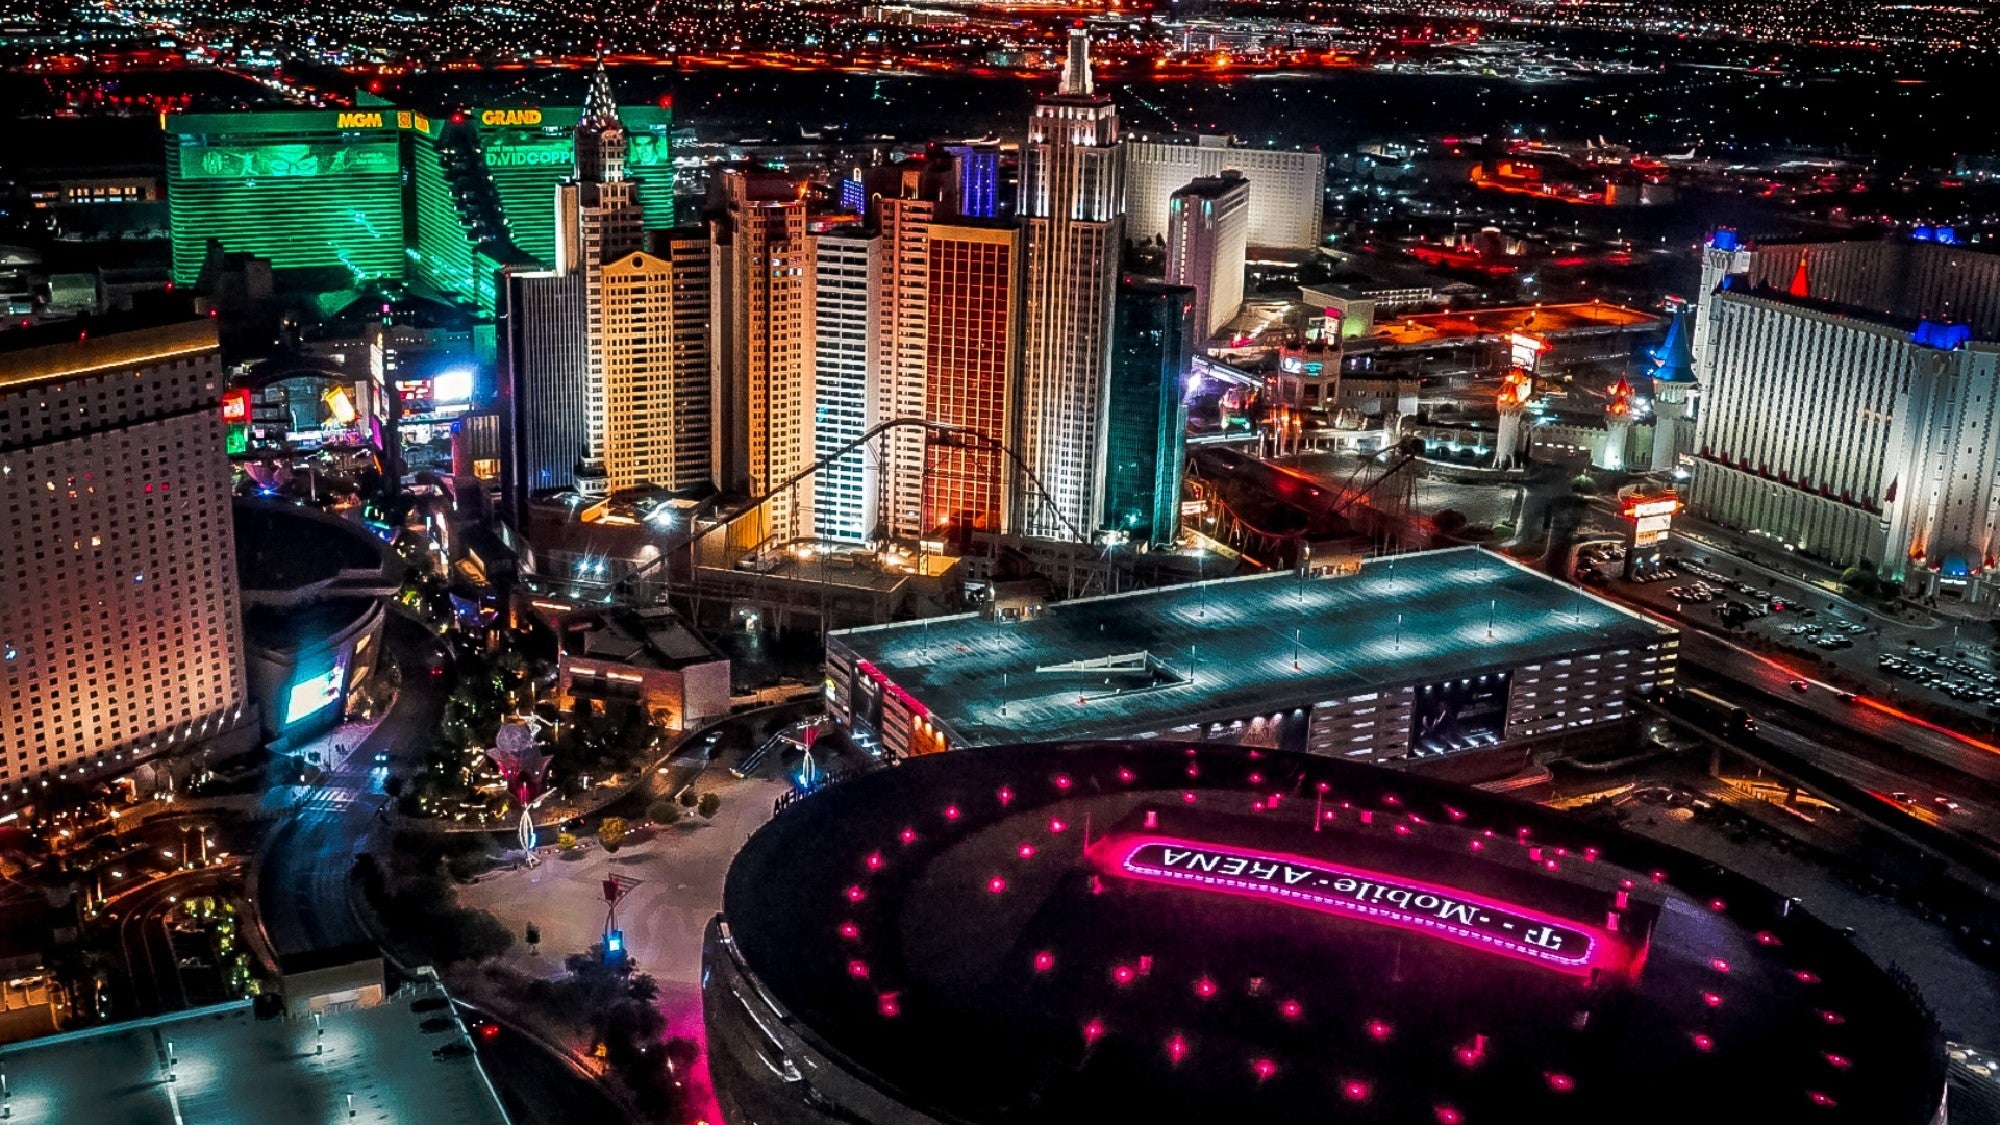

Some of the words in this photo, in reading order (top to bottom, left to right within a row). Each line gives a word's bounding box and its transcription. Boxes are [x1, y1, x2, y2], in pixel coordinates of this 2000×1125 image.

[337, 113, 383, 128] MGM
[482, 109, 542, 126] GRAND
[1164, 849, 1312, 885] ARENA
